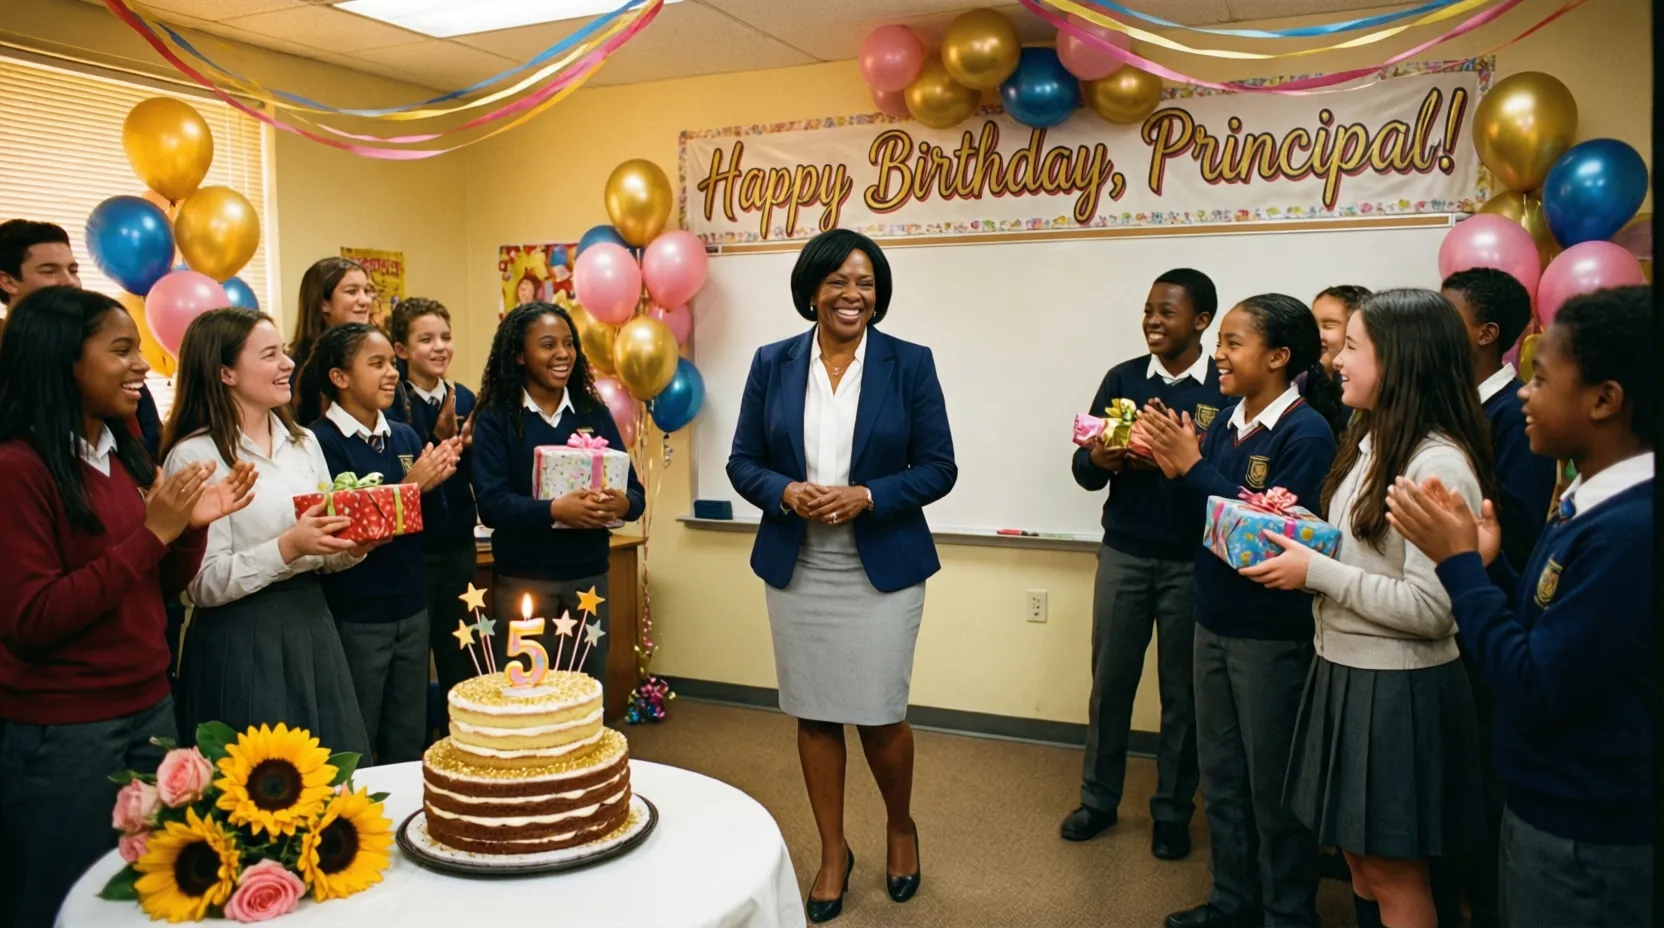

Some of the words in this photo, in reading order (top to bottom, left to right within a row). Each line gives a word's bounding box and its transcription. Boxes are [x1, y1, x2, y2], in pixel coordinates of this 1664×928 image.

[698, 141, 853, 239] Happy
[864, 120, 1126, 224] Birthday,
[1141, 87, 1468, 210] Principal!
[504, 618, 549, 688] 5
